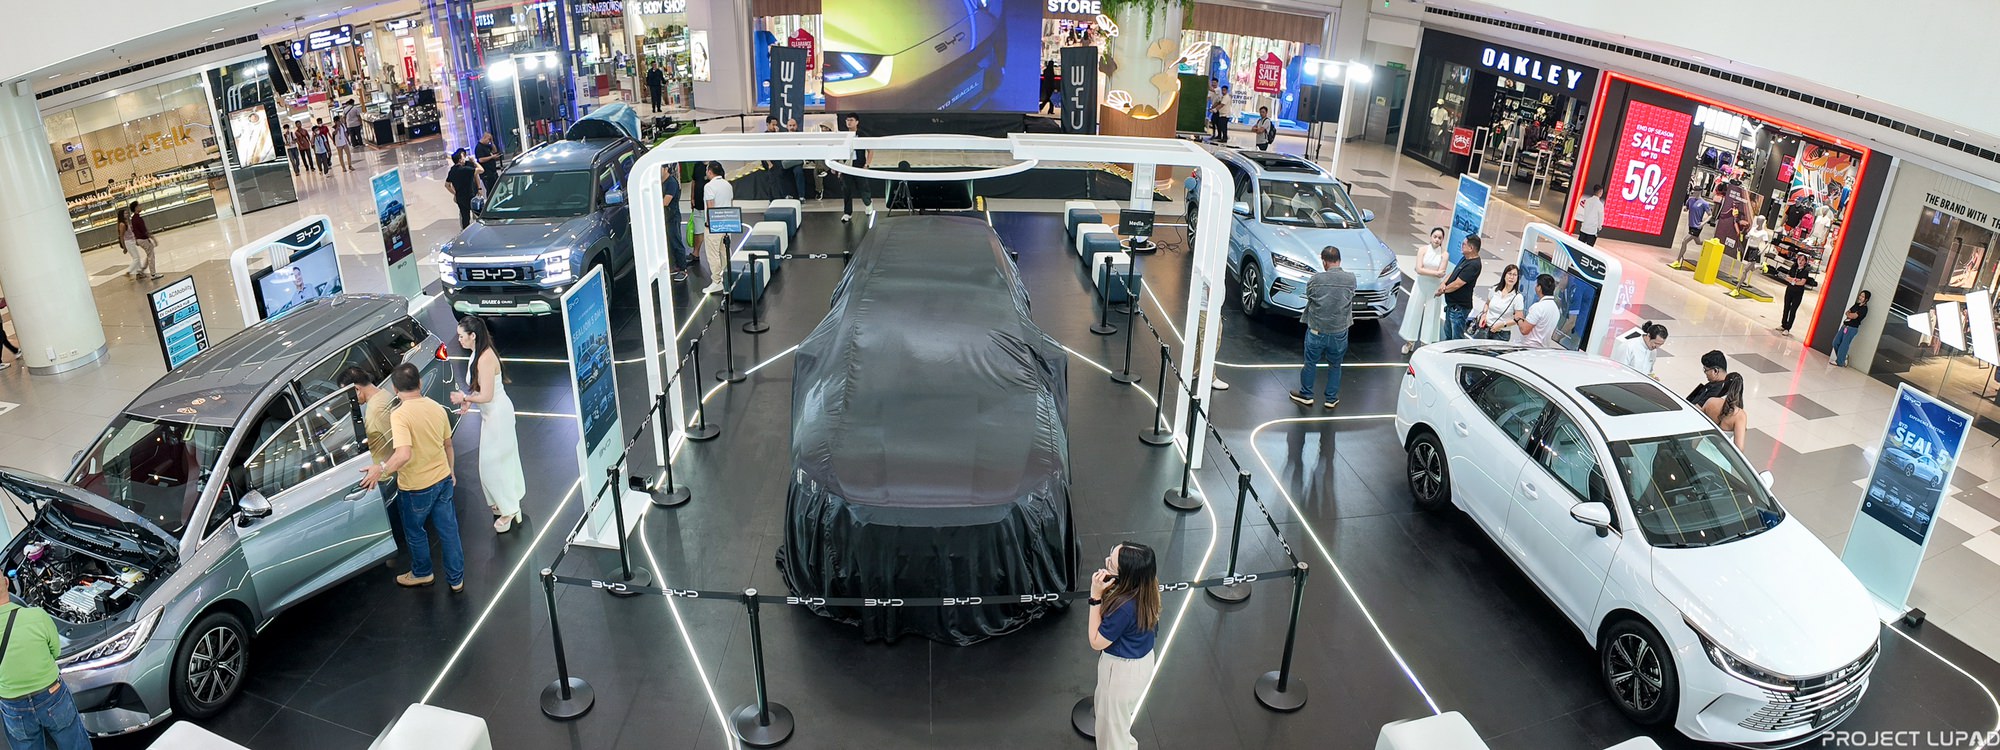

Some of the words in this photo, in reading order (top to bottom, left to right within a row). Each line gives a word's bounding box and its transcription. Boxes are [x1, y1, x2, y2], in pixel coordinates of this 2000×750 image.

[643, 1, 662, 14] BODY
[663, 0, 685, 13] SHOP
[1047, 0, 1101, 15] STORE
[475, 13, 494, 27] GUESS
[934, 31, 965, 53] BYD
[1258, 69, 1279, 81] SALE
[1482, 47, 1582, 90] OAKLEY
[1070, 65, 1085, 130] BYD
[1636, 124, 1647, 132] END
[1655, 128, 1675, 138] SEASON
[91, 125, 195, 169] BreadTalk
[1631, 132, 1674, 155] SALE
[1621, 159, 1667, 205] 50%
[1925, 192, 1940, 206] THE
[1940, 198, 1966, 216] BRAND
[1966, 207, 1988, 224] WITH
[296, 224, 321, 243] BYD
[471, 268, 517, 280] BYD
[1894, 427, 1933, 458] SEAL
[1936, 448, 1949, 465] 5
[591, 579, 627, 591] BYD
[1223, 574, 1258, 586] BYD
[661, 588, 699, 598] BYD
[1020, 593, 1059, 603] BYD
[786, 596, 826, 606] BYD
[864, 598, 904, 607] BYD
[943, 597, 982, 606] BYD
